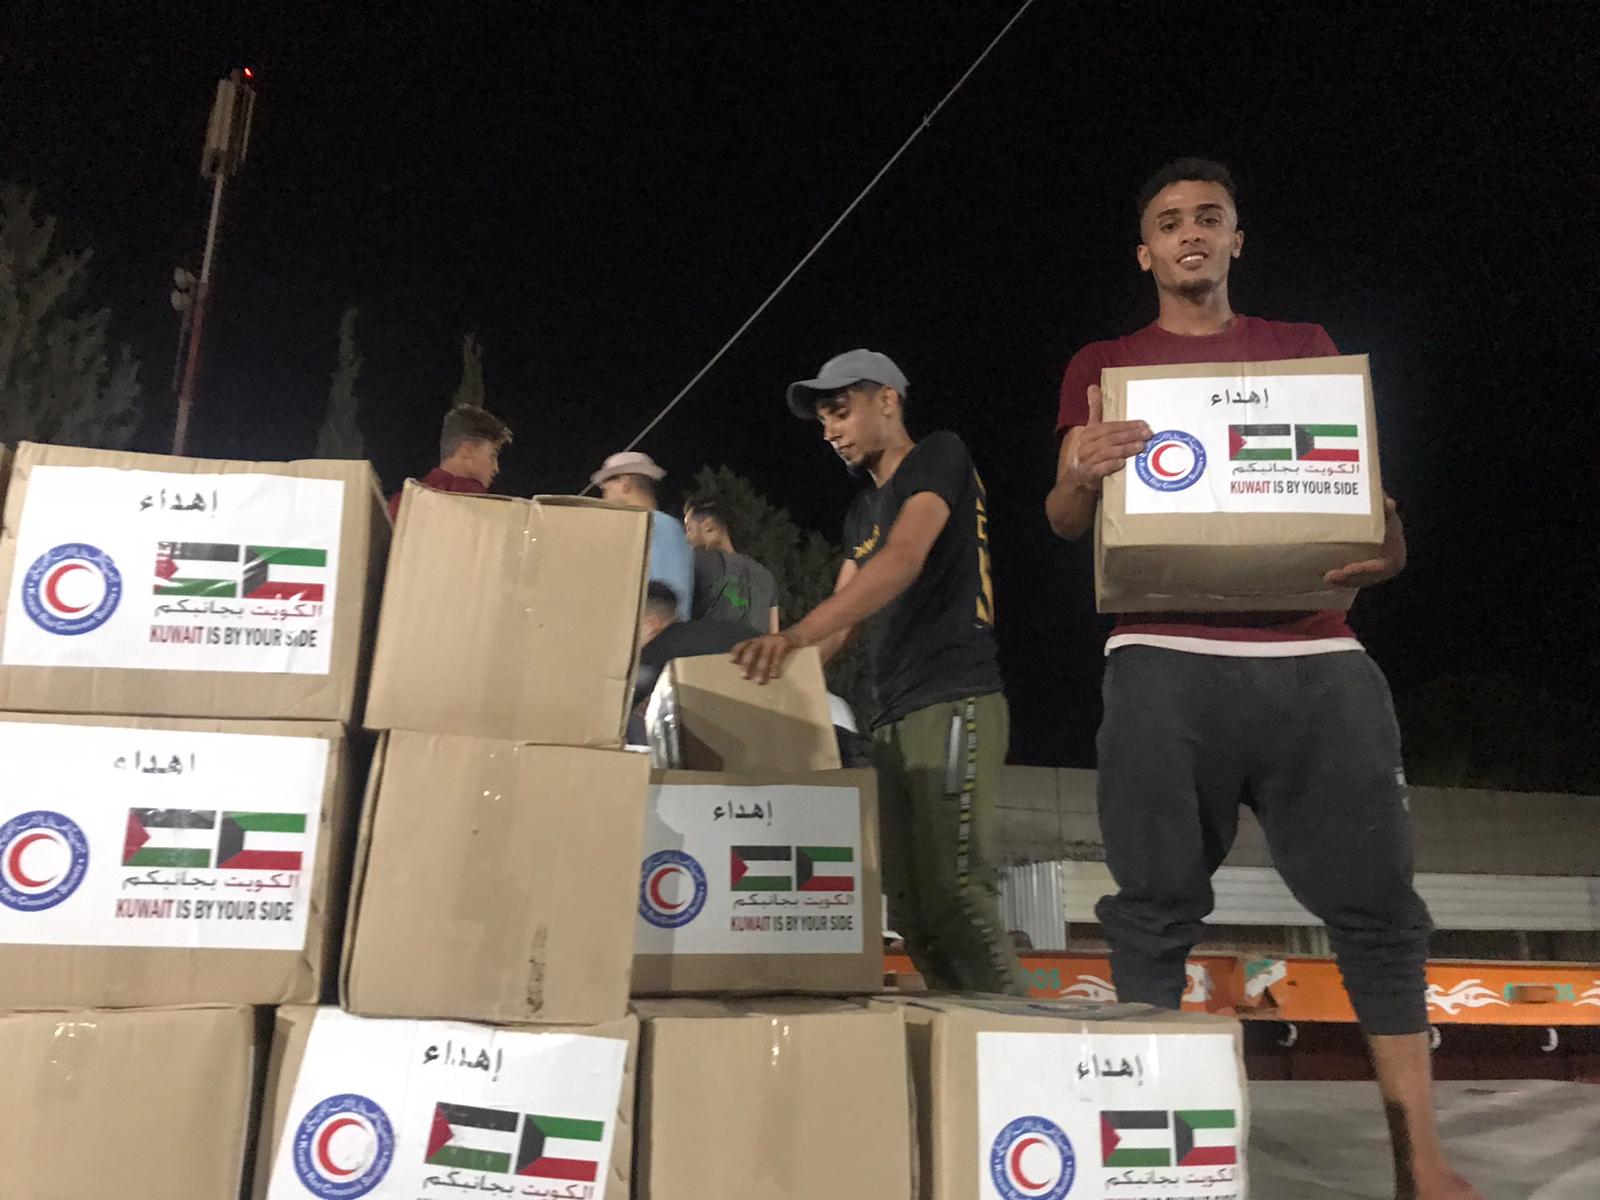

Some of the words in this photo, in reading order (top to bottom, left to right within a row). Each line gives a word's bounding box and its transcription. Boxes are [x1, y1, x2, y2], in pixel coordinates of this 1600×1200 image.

[1210, 388, 1269, 409] إهداء
[1305, 463, 1360, 477] الكويت
[1230, 480, 1271, 494] KUWAIT
[1273, 480, 1284, 494] IS
[1286, 480, 1300, 494] BY
[1300, 481, 1331, 495] YOUR
[1333, 481, 1359, 496] SIDE
[250, 603, 323, 621] الكويت
[150, 624, 204, 644] KUWAIT
[206, 626, 221, 645] IS
[224, 627, 243, 646] BY
[245, 627, 282, 647] YOUR
[712, 800, 773, 827] إهداء
[224, 873, 300, 893] الكويت
[115, 898, 174, 919] KUWAIT
[176, 899, 192, 919] IS
[194, 899, 216, 920] BY
[217, 900, 257, 921] YOUR
[259, 901, 293, 922] SIDE
[730, 916, 770, 931] KUWAIT
[773, 916, 783, 931] IS
[786, 916, 798, 931] BY
[801, 916, 828, 931] YOUR
[830, 915, 853, 931] SIDE
[422, 1040, 503, 1083] إهداء
[1076, 1053, 1144, 1087] إهداء
